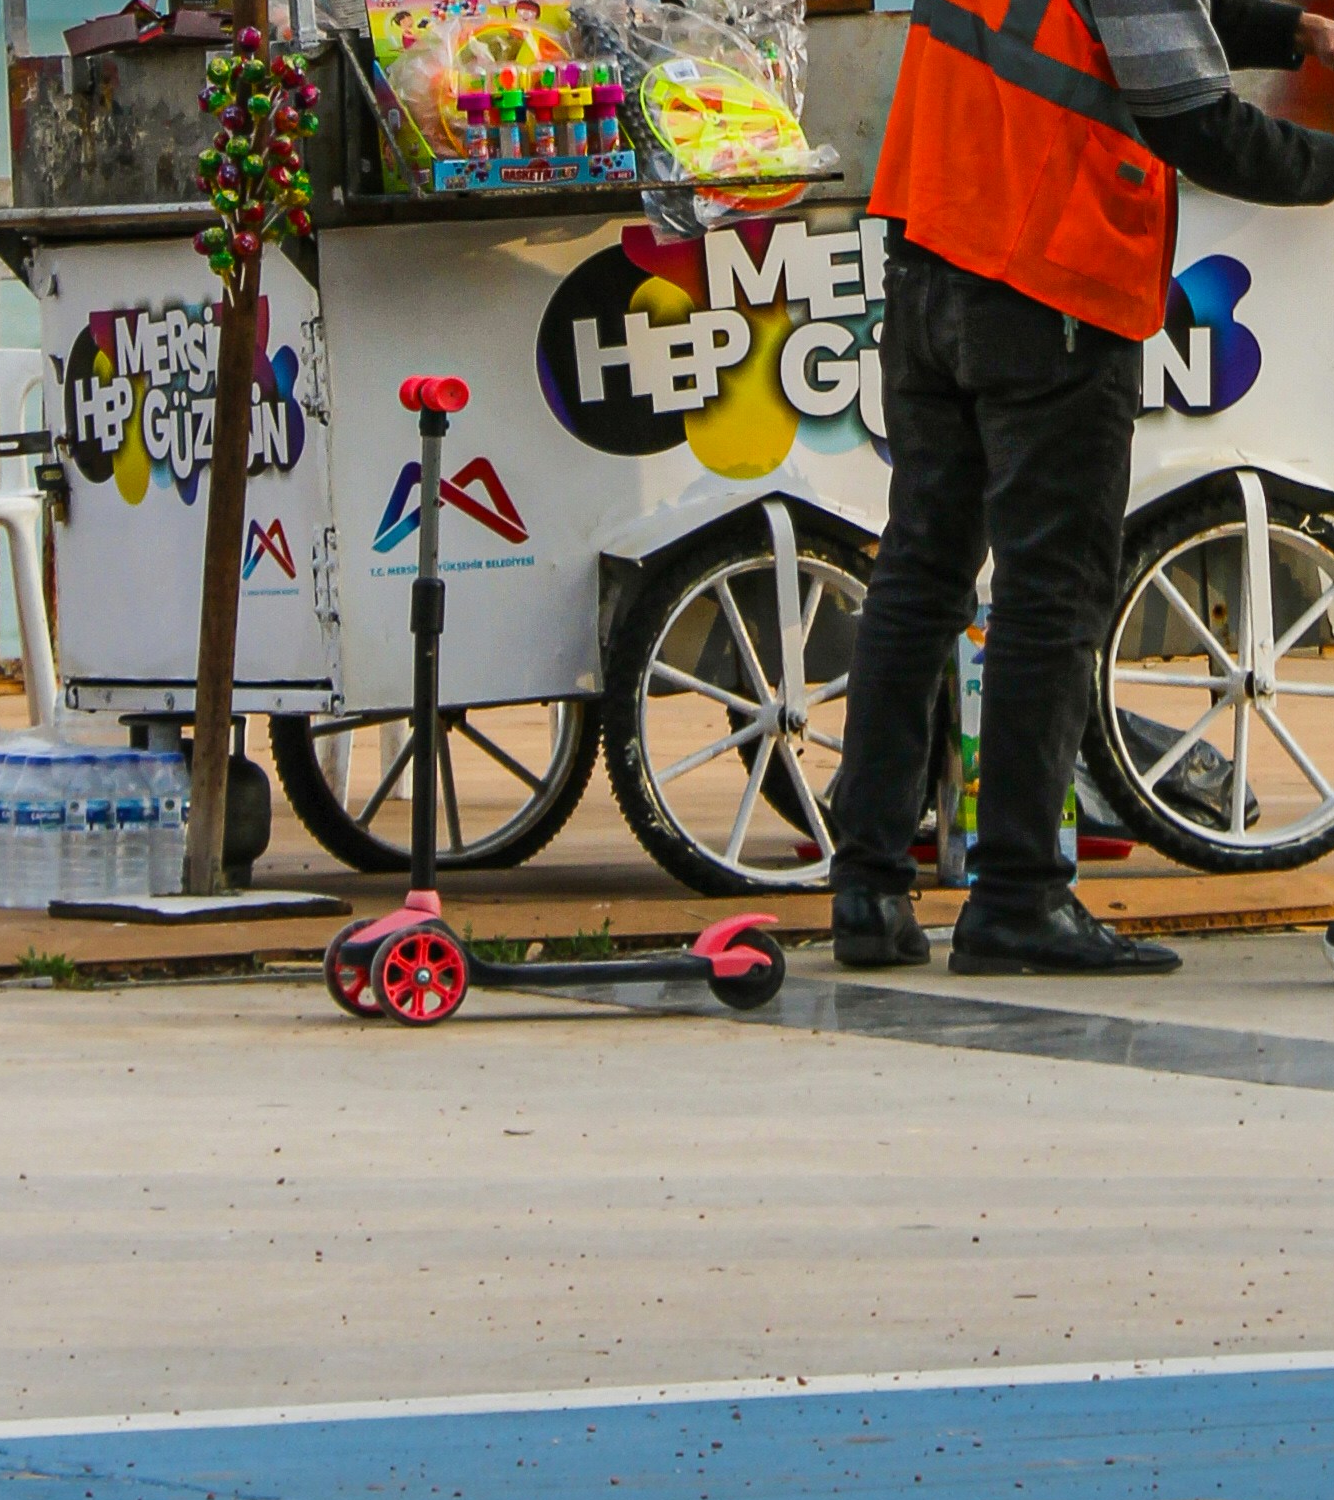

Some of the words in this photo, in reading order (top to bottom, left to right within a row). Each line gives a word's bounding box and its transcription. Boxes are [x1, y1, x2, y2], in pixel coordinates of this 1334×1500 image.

[115, 306, 221, 393] MERSİ
[571, 309, 751, 414] HEP
[74, 375, 133, 452] HEP
[142, 380, 289, 480] GÜZİN
[438, 558, 483, 572] YÜKŞEHİR
